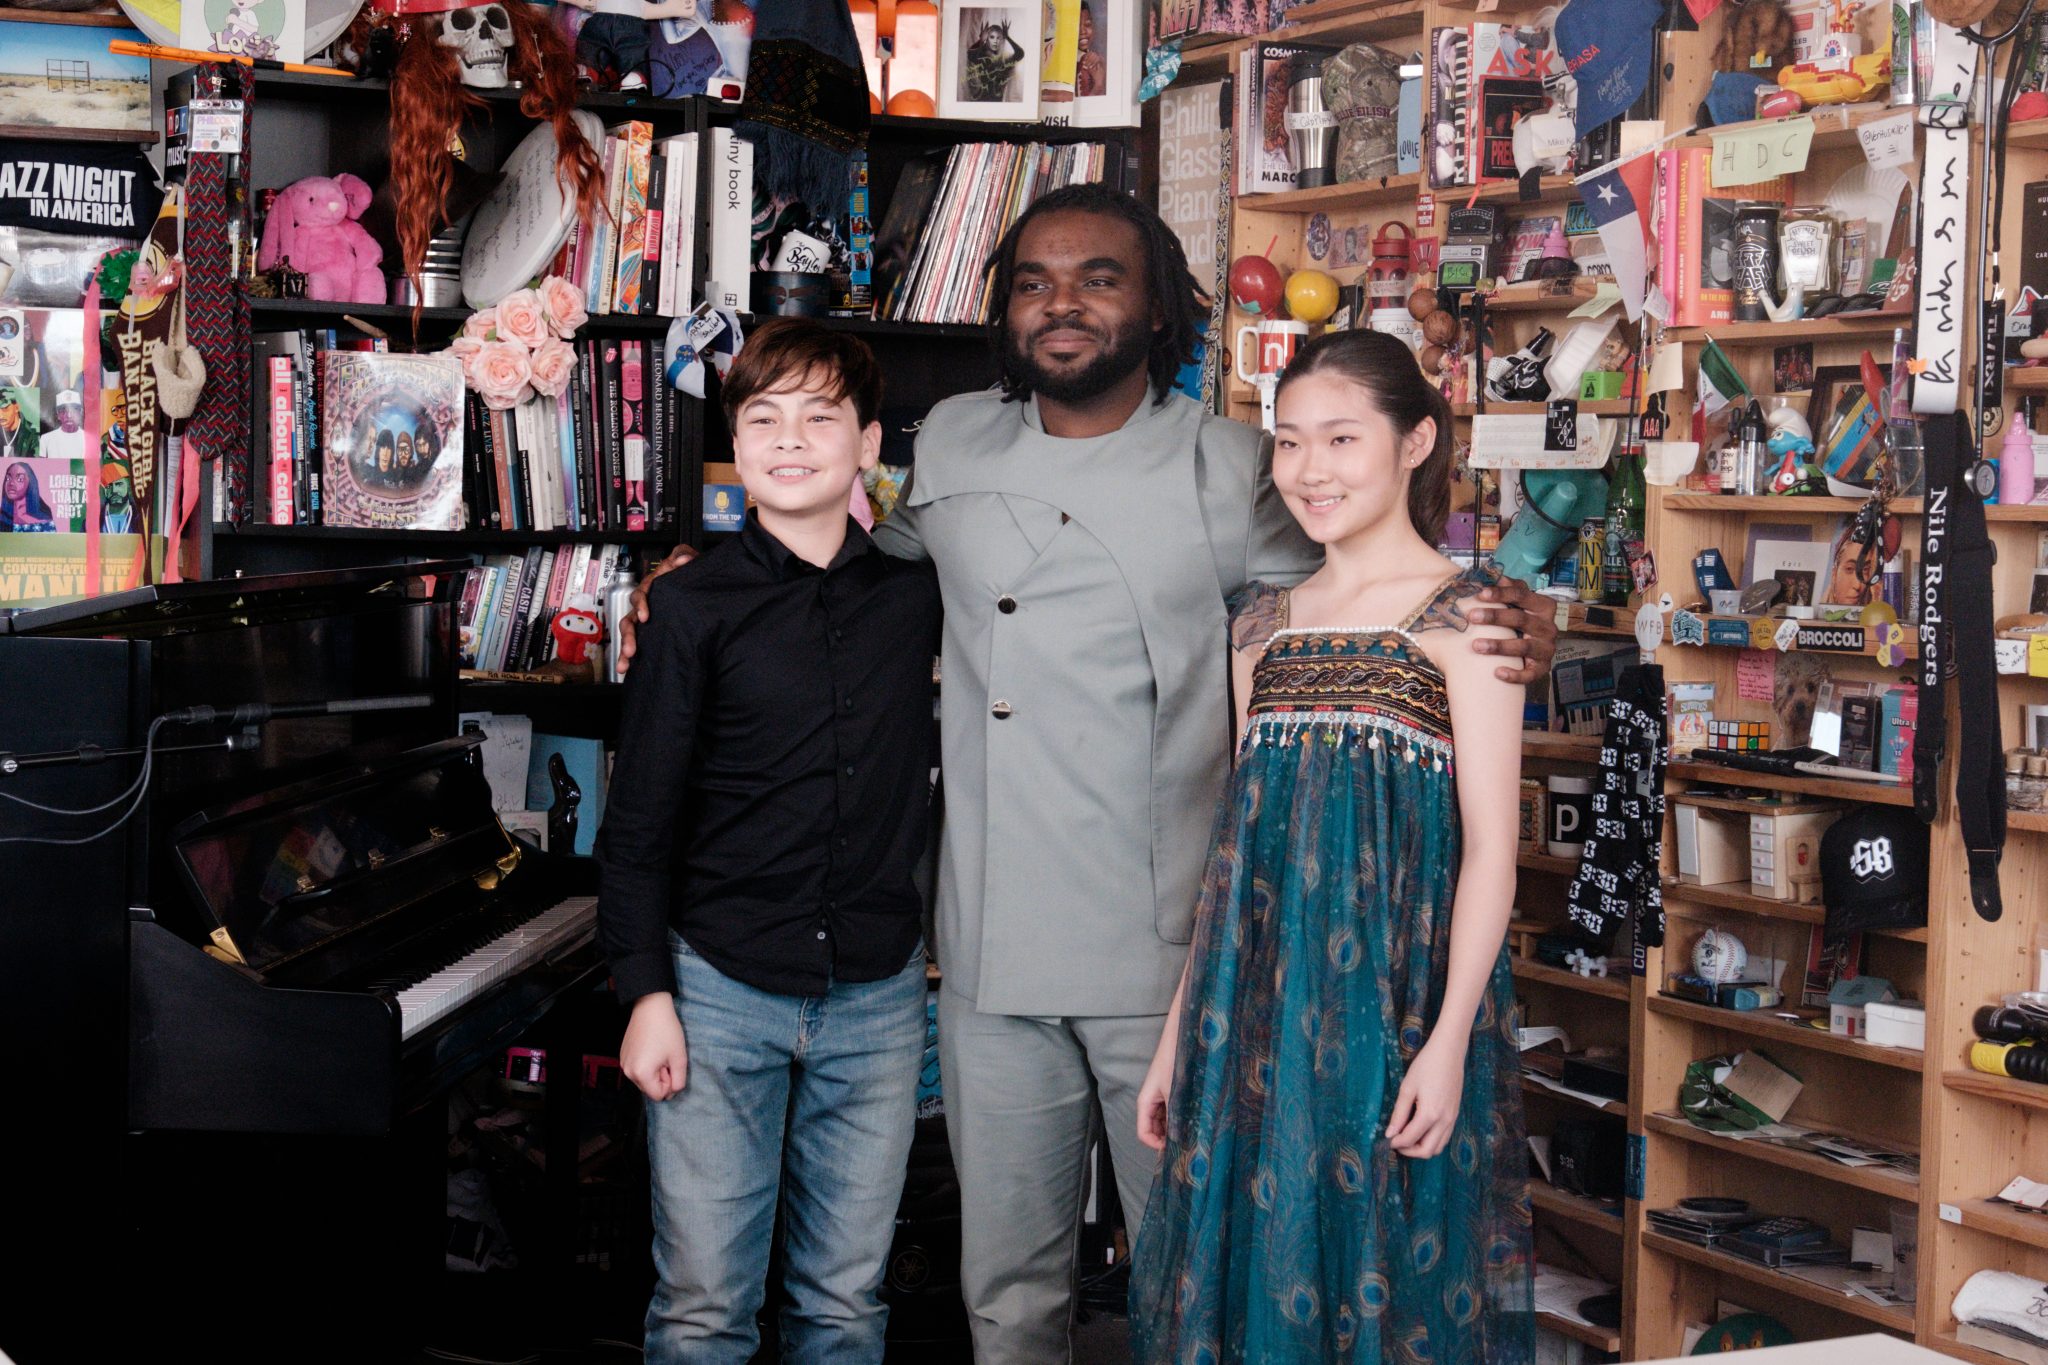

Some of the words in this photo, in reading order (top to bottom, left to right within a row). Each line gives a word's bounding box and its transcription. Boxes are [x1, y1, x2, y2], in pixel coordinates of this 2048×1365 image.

[1487, 48, 1554, 77] ASK
[1356, 106, 1391, 117] EILISH
[167, 140, 187, 167] music
[726, 134, 737, 164] tiny
[1160, 141, 1221, 182] Glass
[1399, 139, 1420, 161] LOUIE
[53, 163, 137, 204] NIGHT
[727, 169, 740, 210] book
[1262, 171, 1296, 183] MARC
[30, 200, 49, 218] IN
[51, 200, 135, 227] AMERICA
[306, 342, 314, 357] The
[1264, 343, 1284, 367] n
[117, 329, 142, 420] BANJO
[140, 336, 161, 427] BLACK
[274, 357, 292, 383] all
[306, 358, 316, 386] Beatles
[654, 358, 663, 401] LEONARD
[609, 379, 618, 399] THE
[307, 398, 317, 421] Apple
[610, 399, 619, 439] ROLLING
[274, 396, 292, 462] about
[308, 421, 318, 450] Records
[655, 402, 663, 452] BERNSTEIN
[482, 430, 493, 455] LIVES
[128, 426, 145, 499] MAGIC
[141, 430, 154, 488] GIRL
[611, 441, 621, 476] STONES
[655, 453, 663, 464] AT
[311, 473, 319, 491] BRUCE
[655, 464, 664, 495] WORK
[50, 490, 80, 504] THAN
[275, 473, 293, 525] cake
[311, 491, 320, 511] SPIZER
[56, 504, 83, 518] RIOT
[703, 512, 720, 521] FROM
[720, 513, 730, 521] THE
[730, 513, 742, 522] TOP
[1926, 486, 1948, 553] Nile
[105, 563, 130, 576] WIT
[518, 587, 533, 614] CASH
[1798, 629, 1863, 648] BROCCOLI
[1919, 563, 1943, 687] Rodgers
[1891, 717, 1910, 726] Ultra
[1555, 804, 1580, 841] p
